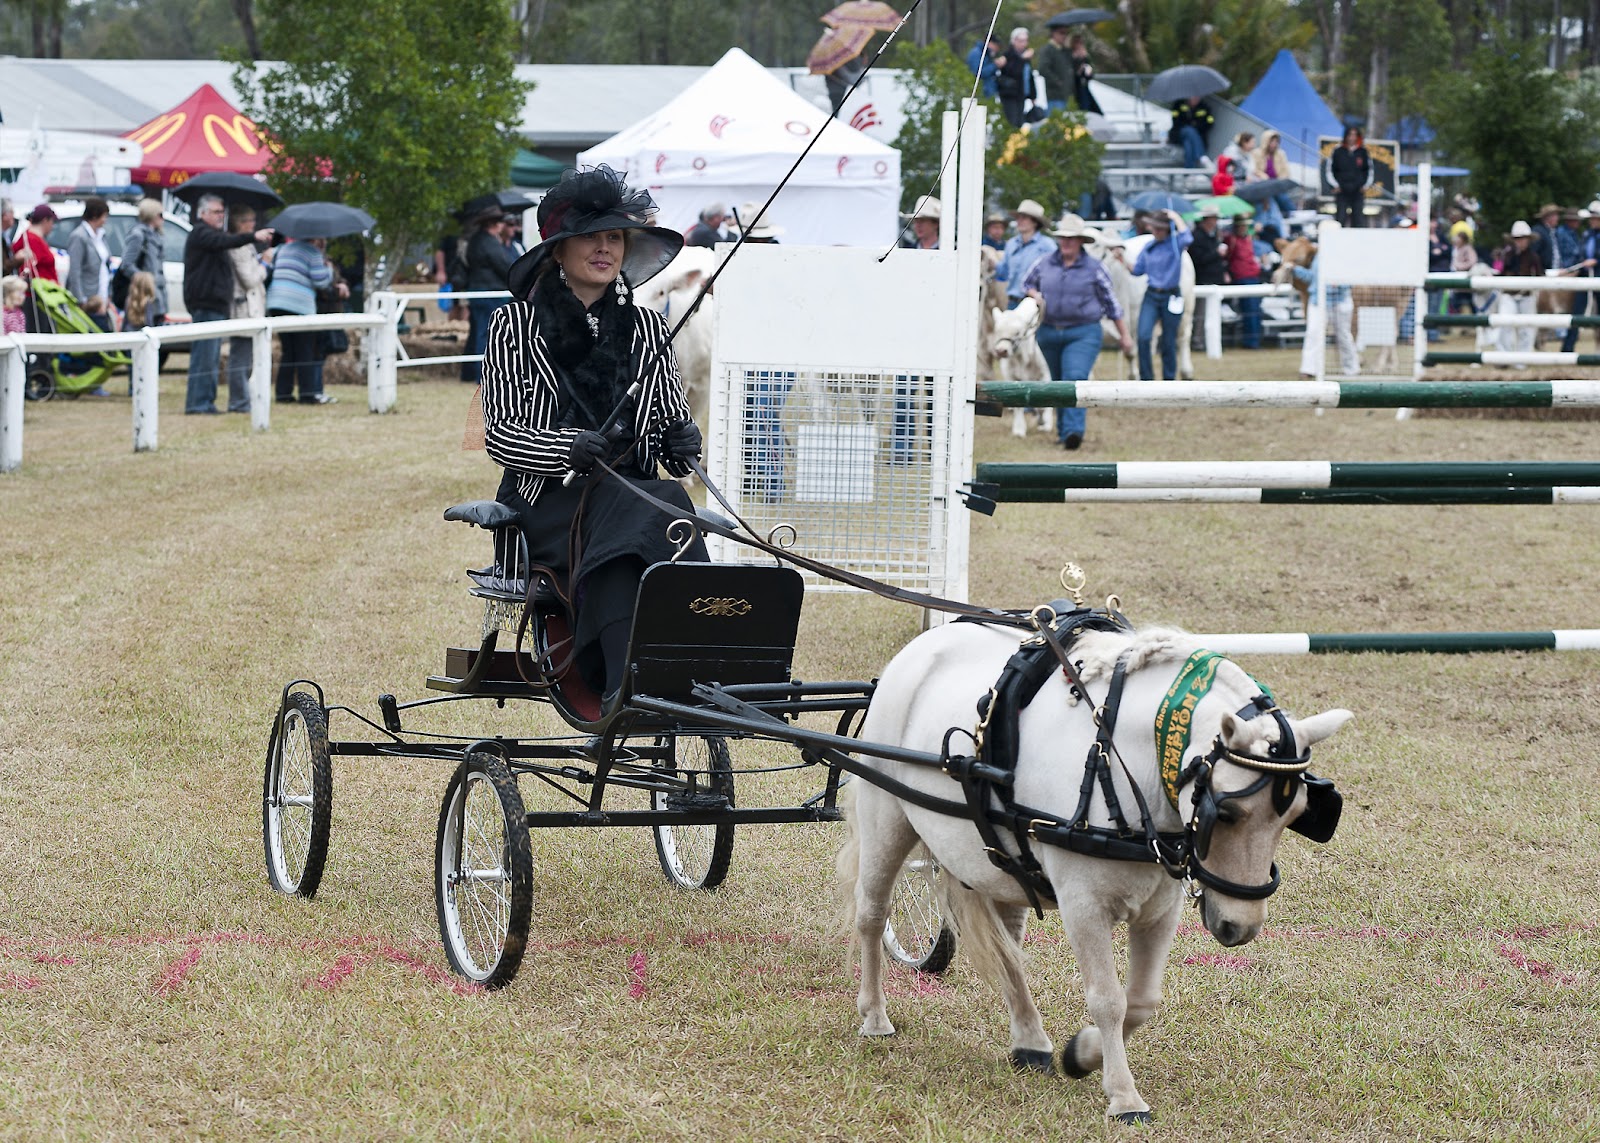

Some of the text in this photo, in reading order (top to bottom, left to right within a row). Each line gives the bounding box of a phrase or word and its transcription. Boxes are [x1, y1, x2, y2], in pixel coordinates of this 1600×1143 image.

[1156, 699, 1169, 729] Show
[1168, 662, 1194, 697] Society
[1162, 709, 1180, 780] ESERVE
